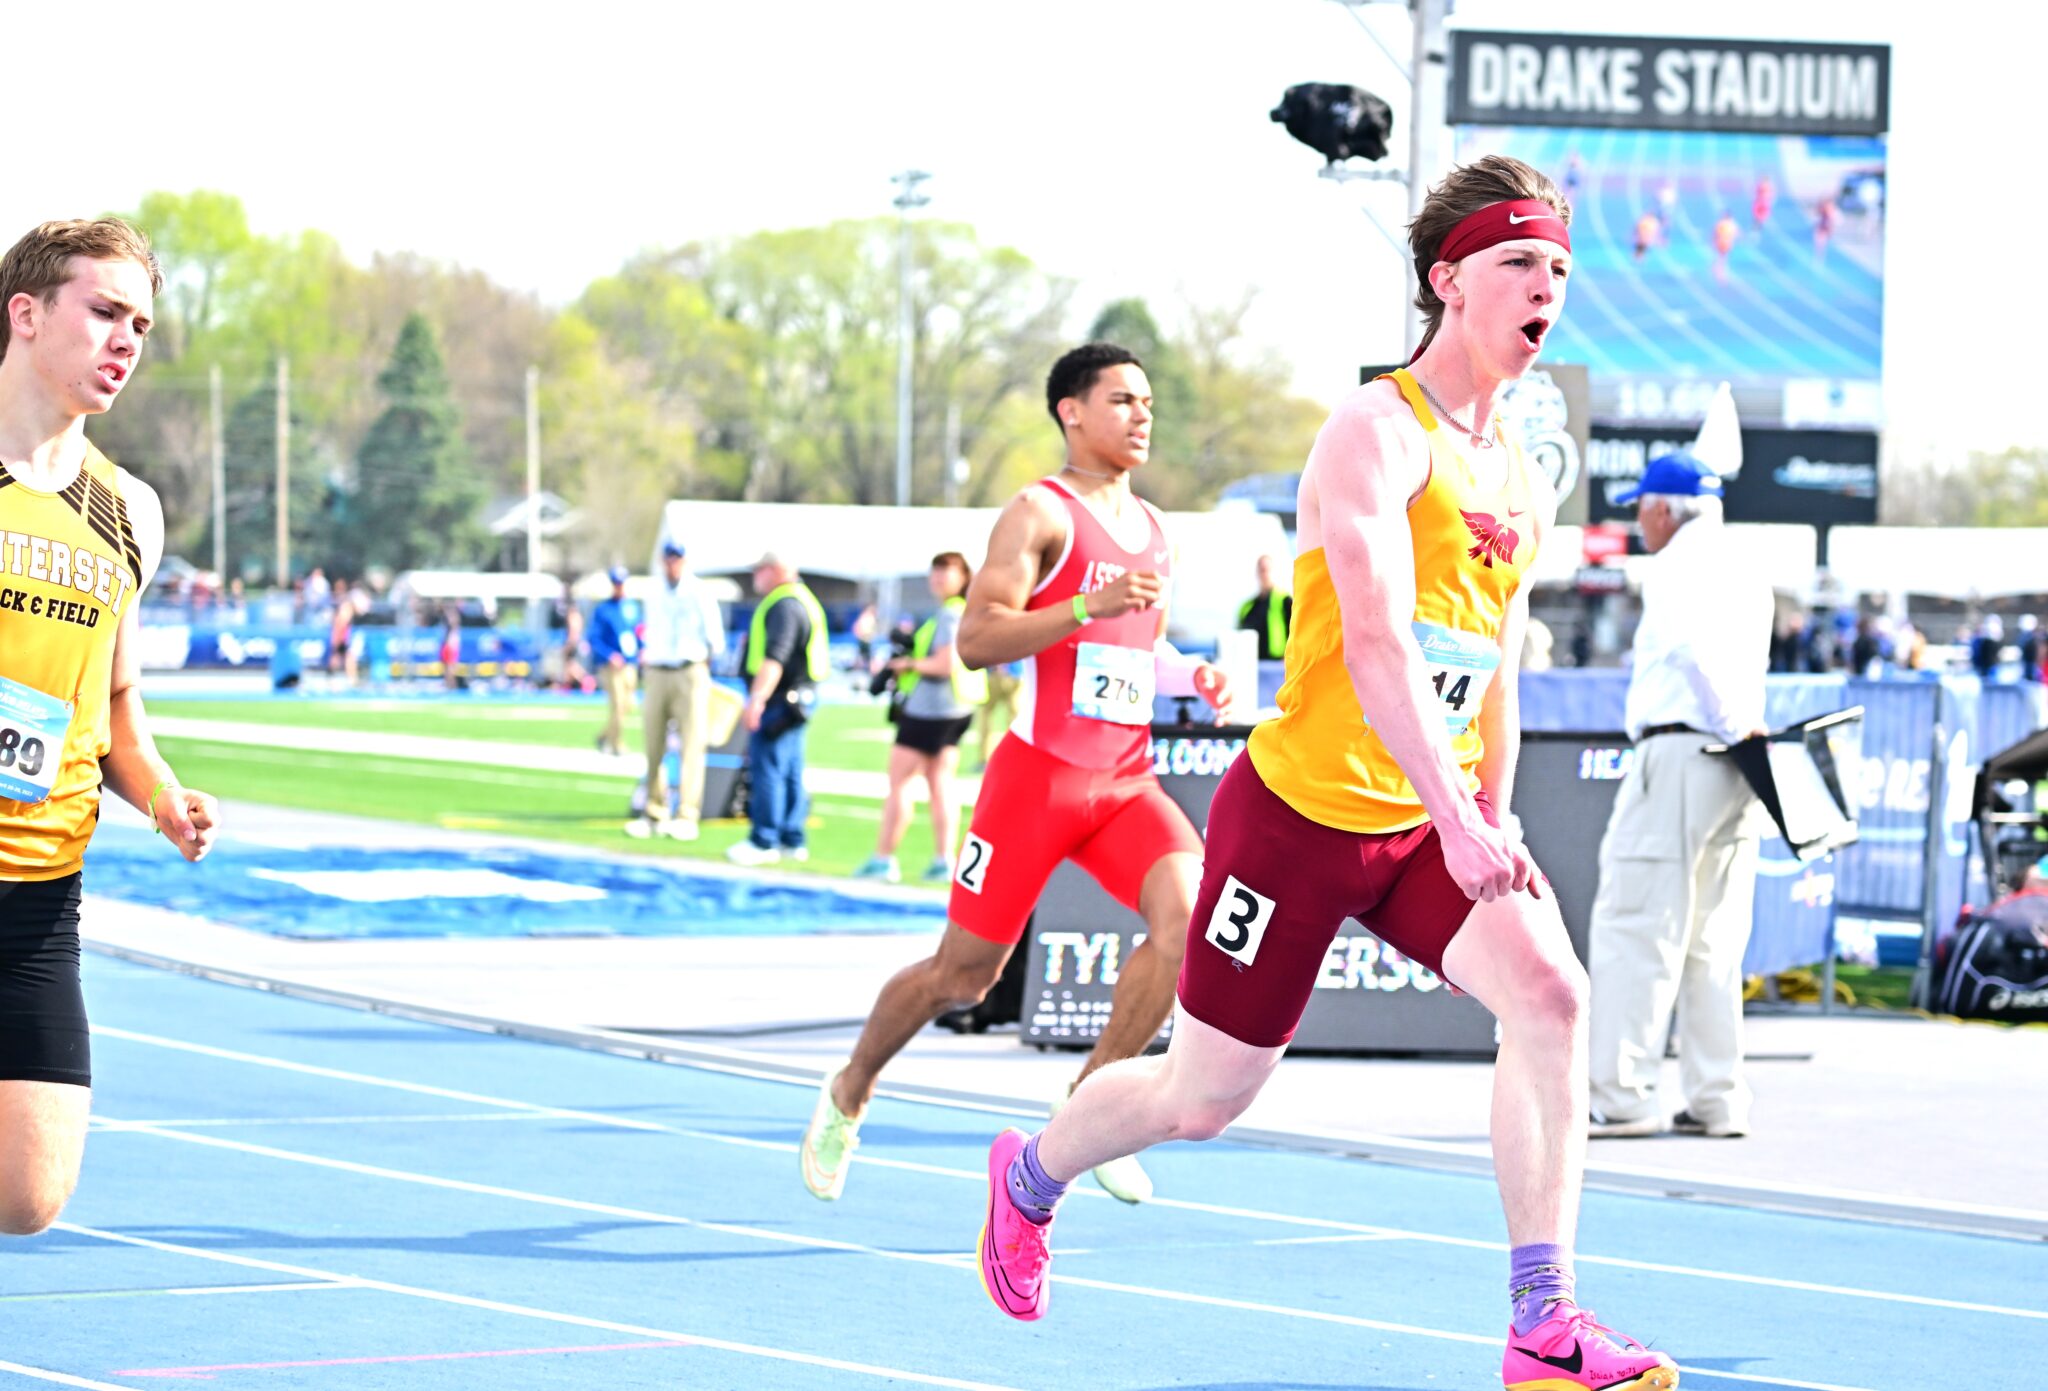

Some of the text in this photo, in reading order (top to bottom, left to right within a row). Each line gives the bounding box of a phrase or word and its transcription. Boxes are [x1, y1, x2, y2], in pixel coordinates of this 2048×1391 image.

[1467, 42, 1880, 121] DRAKE STADIUM
[0, 529, 133, 617] TERSET
[45, 598, 100, 628] FIELD
[1094, 673, 1140, 704] 276
[961, 840, 983, 888] 2
[1214, 887, 1260, 953] 3
